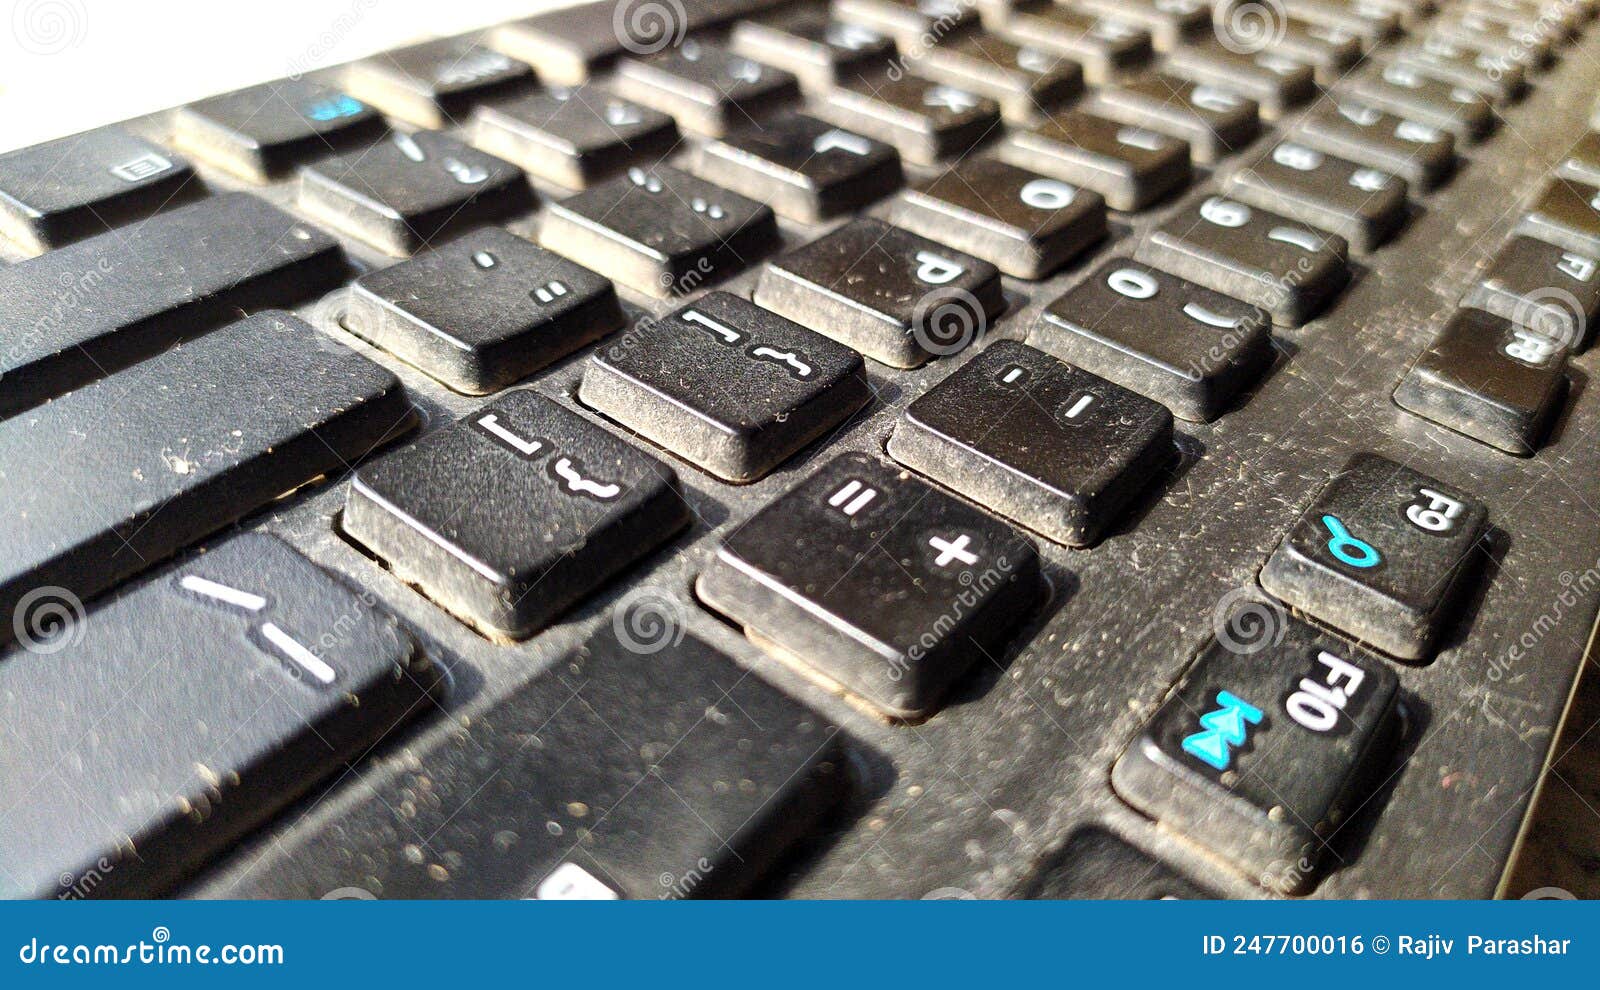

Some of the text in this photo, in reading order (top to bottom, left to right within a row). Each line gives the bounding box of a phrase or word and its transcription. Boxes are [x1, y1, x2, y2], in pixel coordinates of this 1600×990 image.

[915, 251, 964, 284] P
[1406, 488, 1464, 531] F9
[928, 533, 979, 567] +
[1286, 650, 1365, 732] F10
